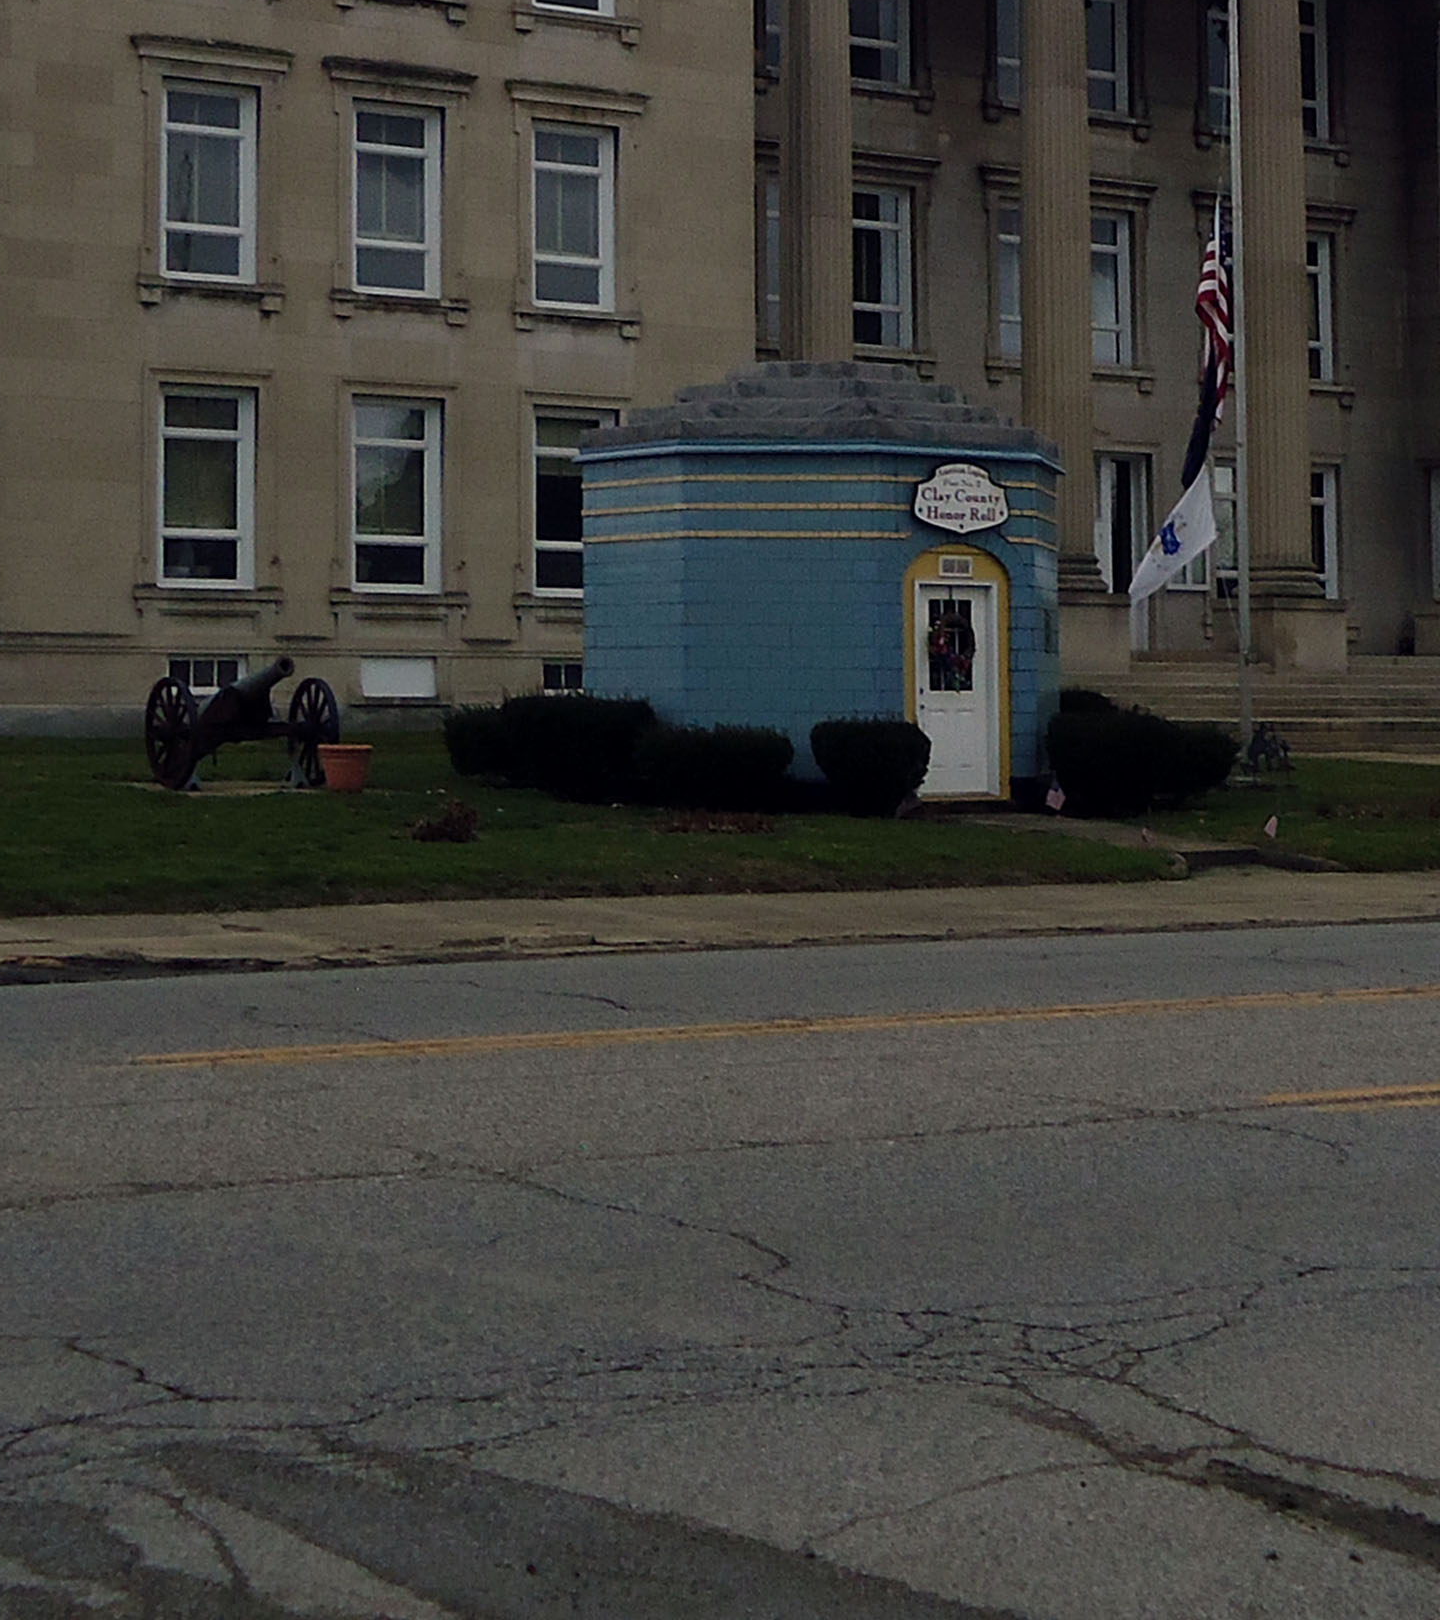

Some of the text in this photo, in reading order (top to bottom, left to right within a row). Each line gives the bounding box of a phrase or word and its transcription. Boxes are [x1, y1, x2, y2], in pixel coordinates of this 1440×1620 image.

[921, 486, 1001, 506] Clay County
[926, 505, 996, 521] Honor Roll
